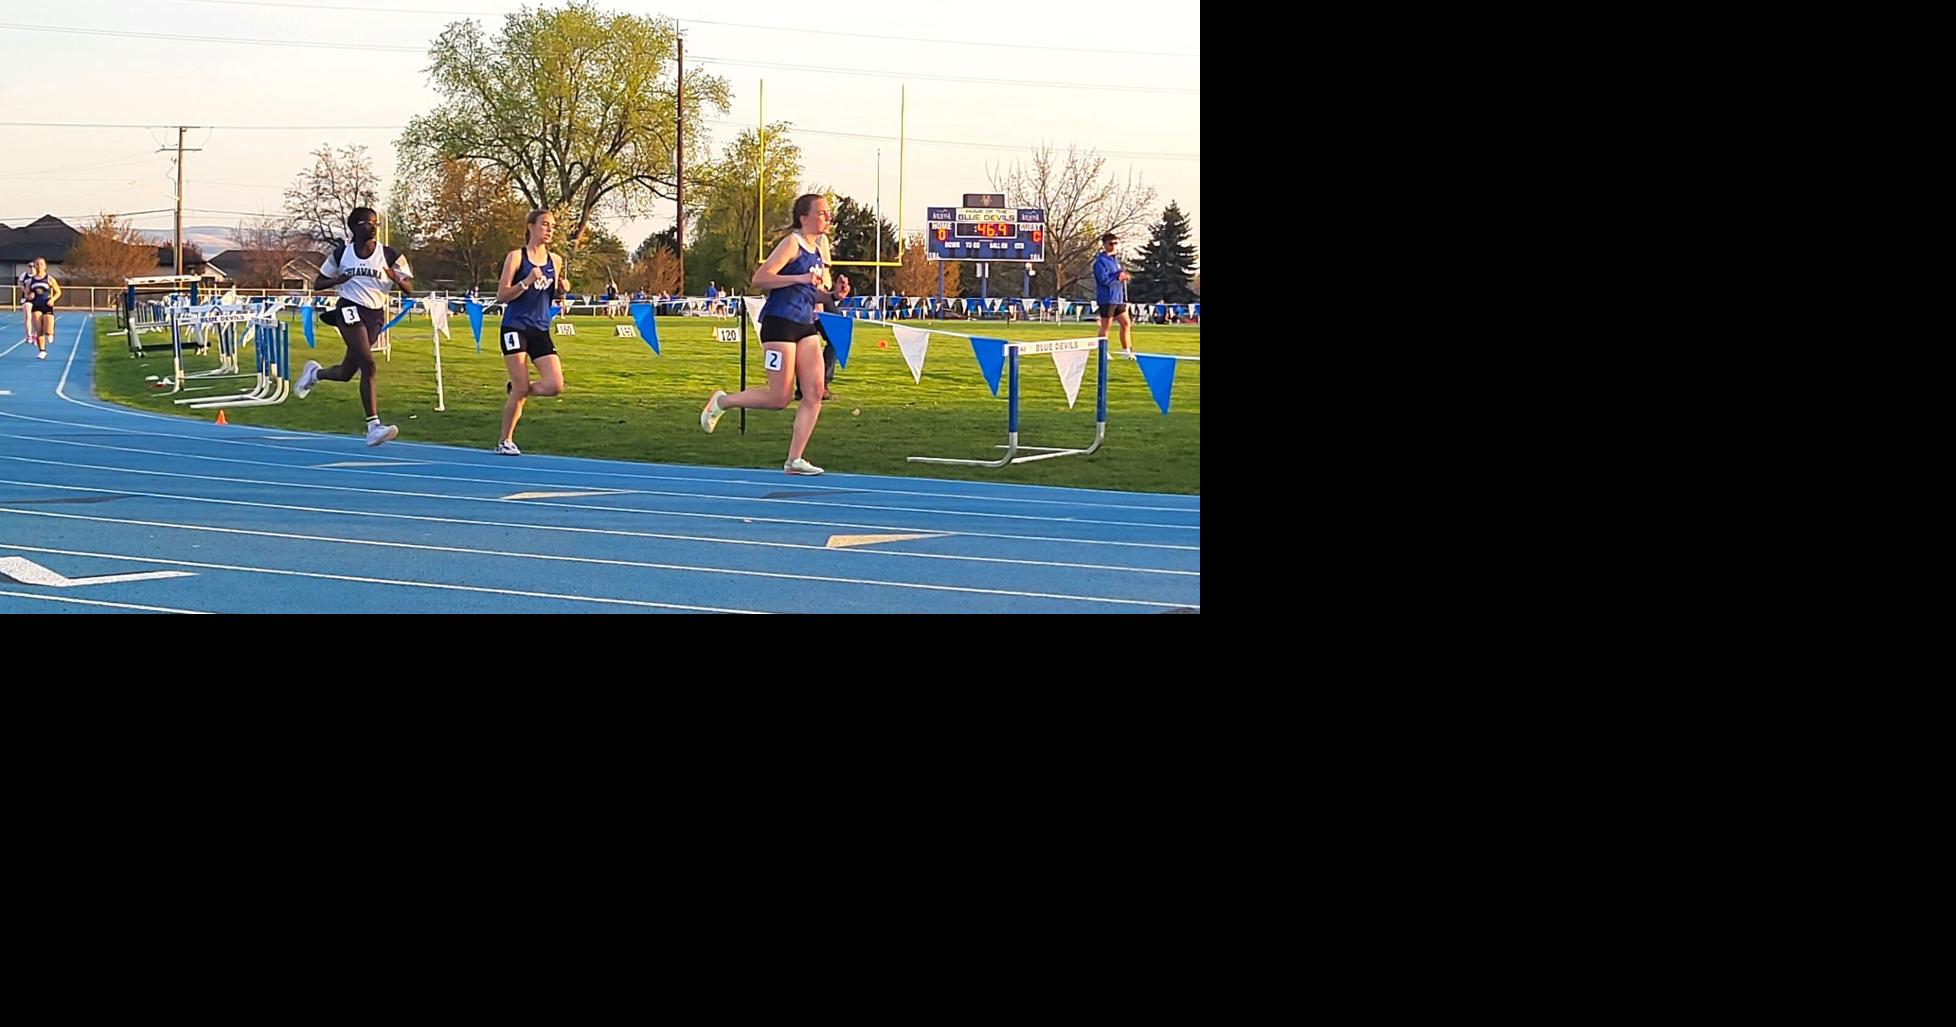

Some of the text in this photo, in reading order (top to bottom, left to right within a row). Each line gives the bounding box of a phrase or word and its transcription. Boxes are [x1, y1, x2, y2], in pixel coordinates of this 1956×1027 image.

[346, 308, 355, 321] 3
[508, 333, 516, 347] 4
[721, 329, 737, 342] 120
[1035, 343, 1053, 352] BLUE
[1055, 341, 1079, 351] DEVILS
[769, 352, 778, 368] 2
